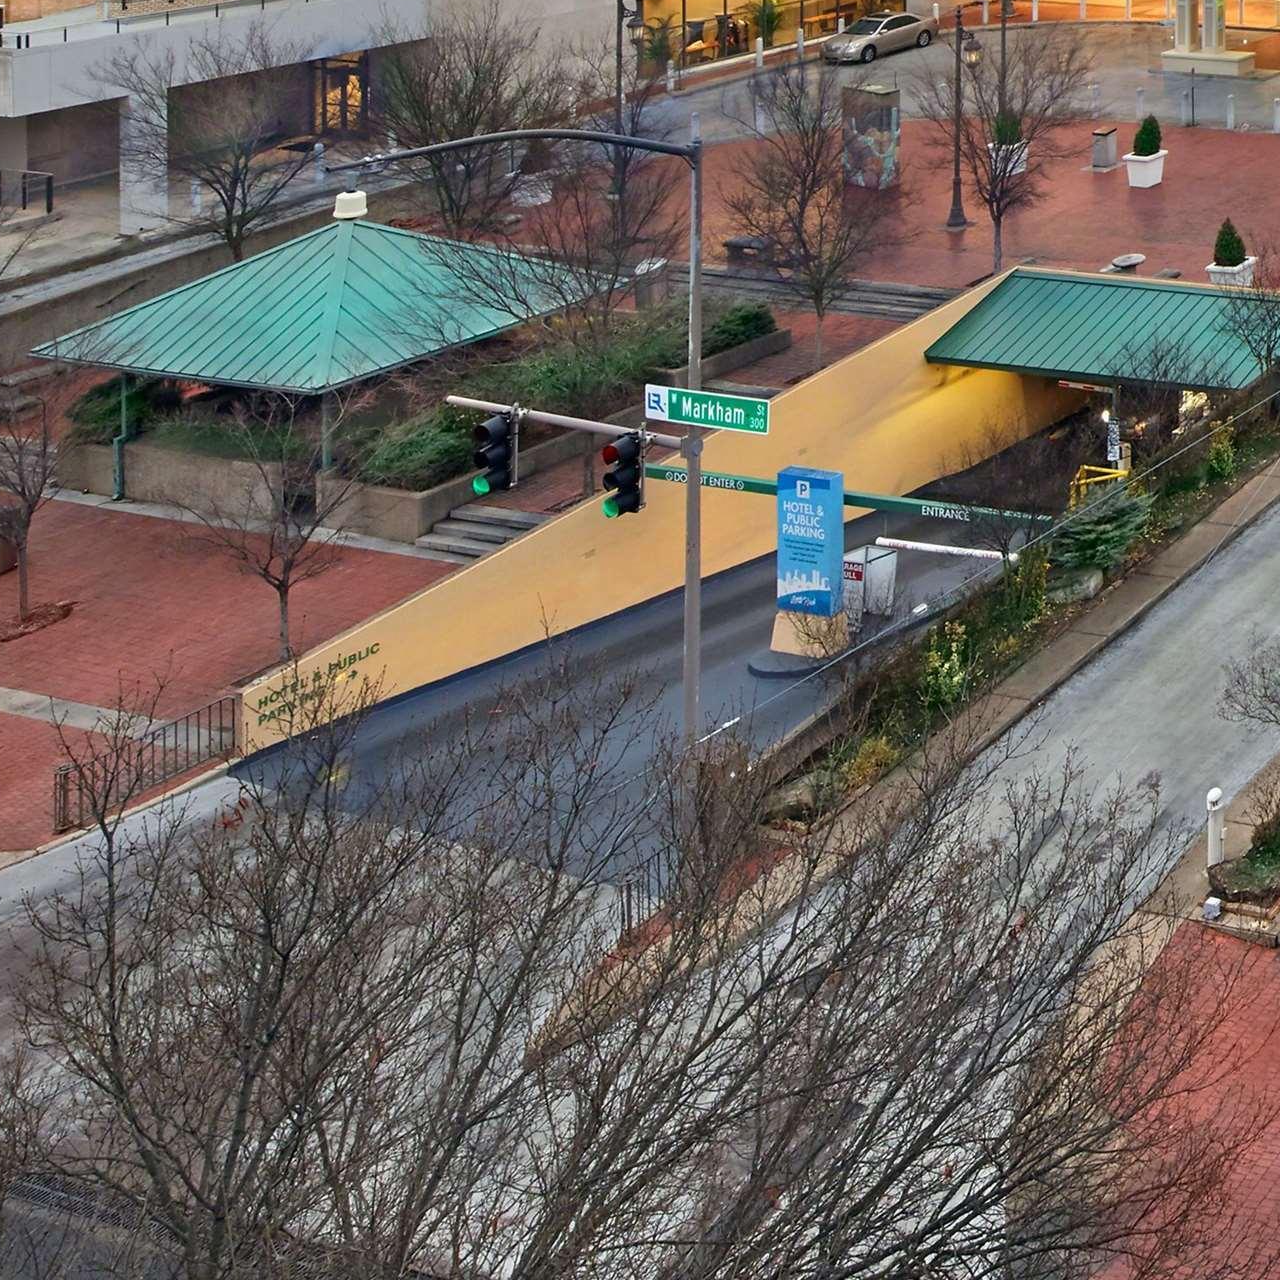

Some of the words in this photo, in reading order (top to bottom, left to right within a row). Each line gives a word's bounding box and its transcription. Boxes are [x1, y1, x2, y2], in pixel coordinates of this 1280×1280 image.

[671, 393, 678, 404] W
[682, 396, 745, 425] Markham
[756, 404, 765, 417] St
[749, 417, 765, 430] 300
[674, 472, 688, 483] DO
[709, 476, 736, 489] ENTER
[799, 483, 808, 496] P
[783, 500, 815, 516] HOTEL
[816, 504, 824, 517] &
[921, 505, 971, 522] ENTRANCE
[786, 512, 821, 528] PUBLIC
[782, 523, 825, 540] PARKING
[843, 570, 857, 580] ULL
[257, 677, 308, 710] HOTEL
[328, 642, 381, 676] PUBLIC
[257, 687, 326, 726] PARING
